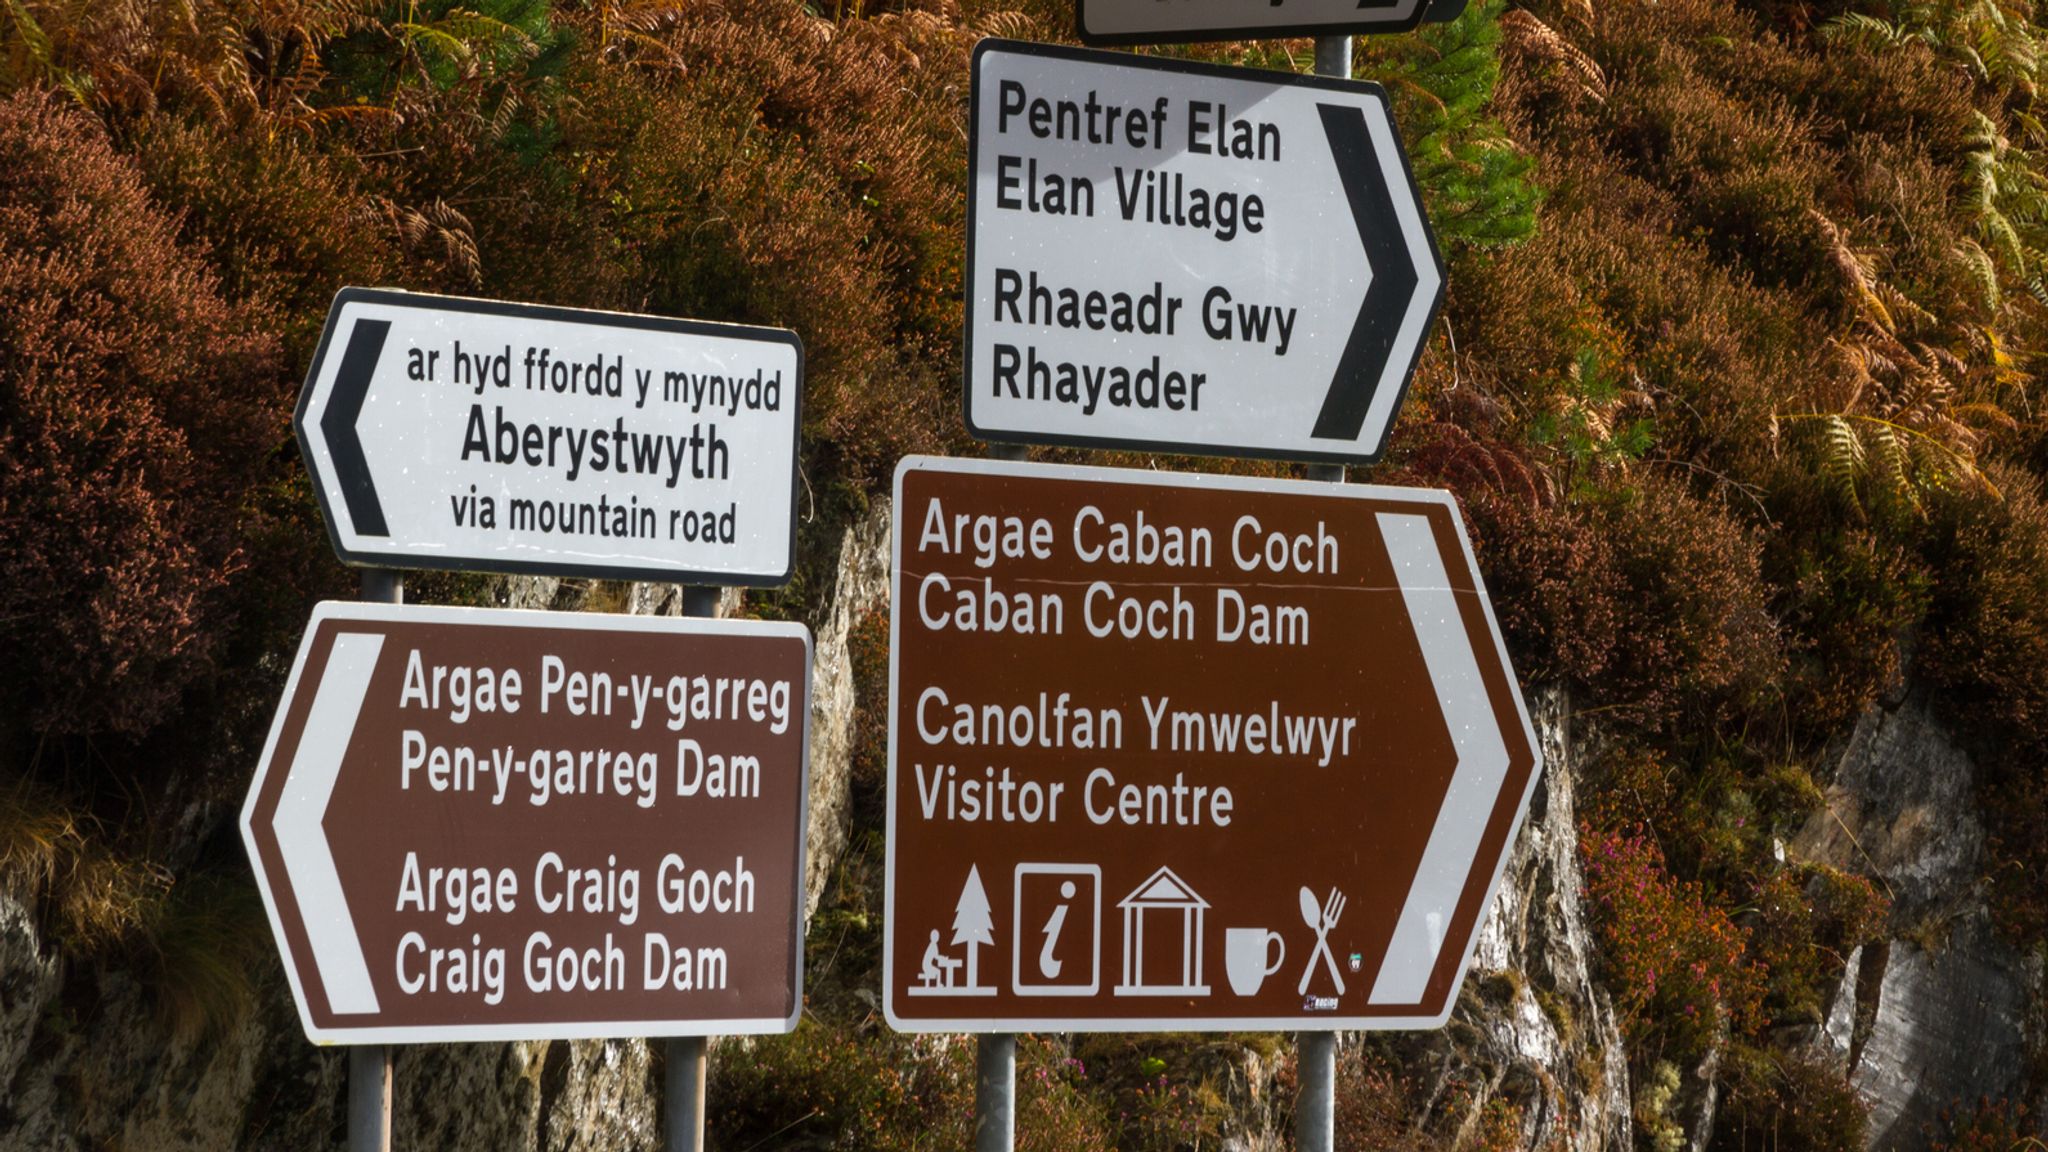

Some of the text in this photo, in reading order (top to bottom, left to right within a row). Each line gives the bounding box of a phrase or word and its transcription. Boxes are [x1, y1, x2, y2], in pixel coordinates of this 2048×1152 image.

[999, 80, 1280, 161] Pentref Elan
[997, 155, 1264, 241] Elan Village
[995, 268, 1296, 356] Rhaeadr Gwy
[408, 341, 781, 416] ar hyd ffordd y mynydd
[993, 344, 1206, 415] Rhayader
[461, 404, 728, 488] Aberystwyth
[451, 484, 735, 544] via mountain road
[919, 498, 1338, 573] Argae Caban Coch
[919, 573, 1308, 645] Caban Coch Dam
[400, 650, 790, 734] Argae Pen-y-garreg
[917, 687, 1356, 766] Canolfan Ymwelwyr
[402, 730, 759, 808] Pen-y-garreg Dam
[915, 764, 1233, 826] Visitor Centre
[396, 852, 754, 925] Argae Craig Goch
[397, 932, 726, 1005] Craig Goch Dam
